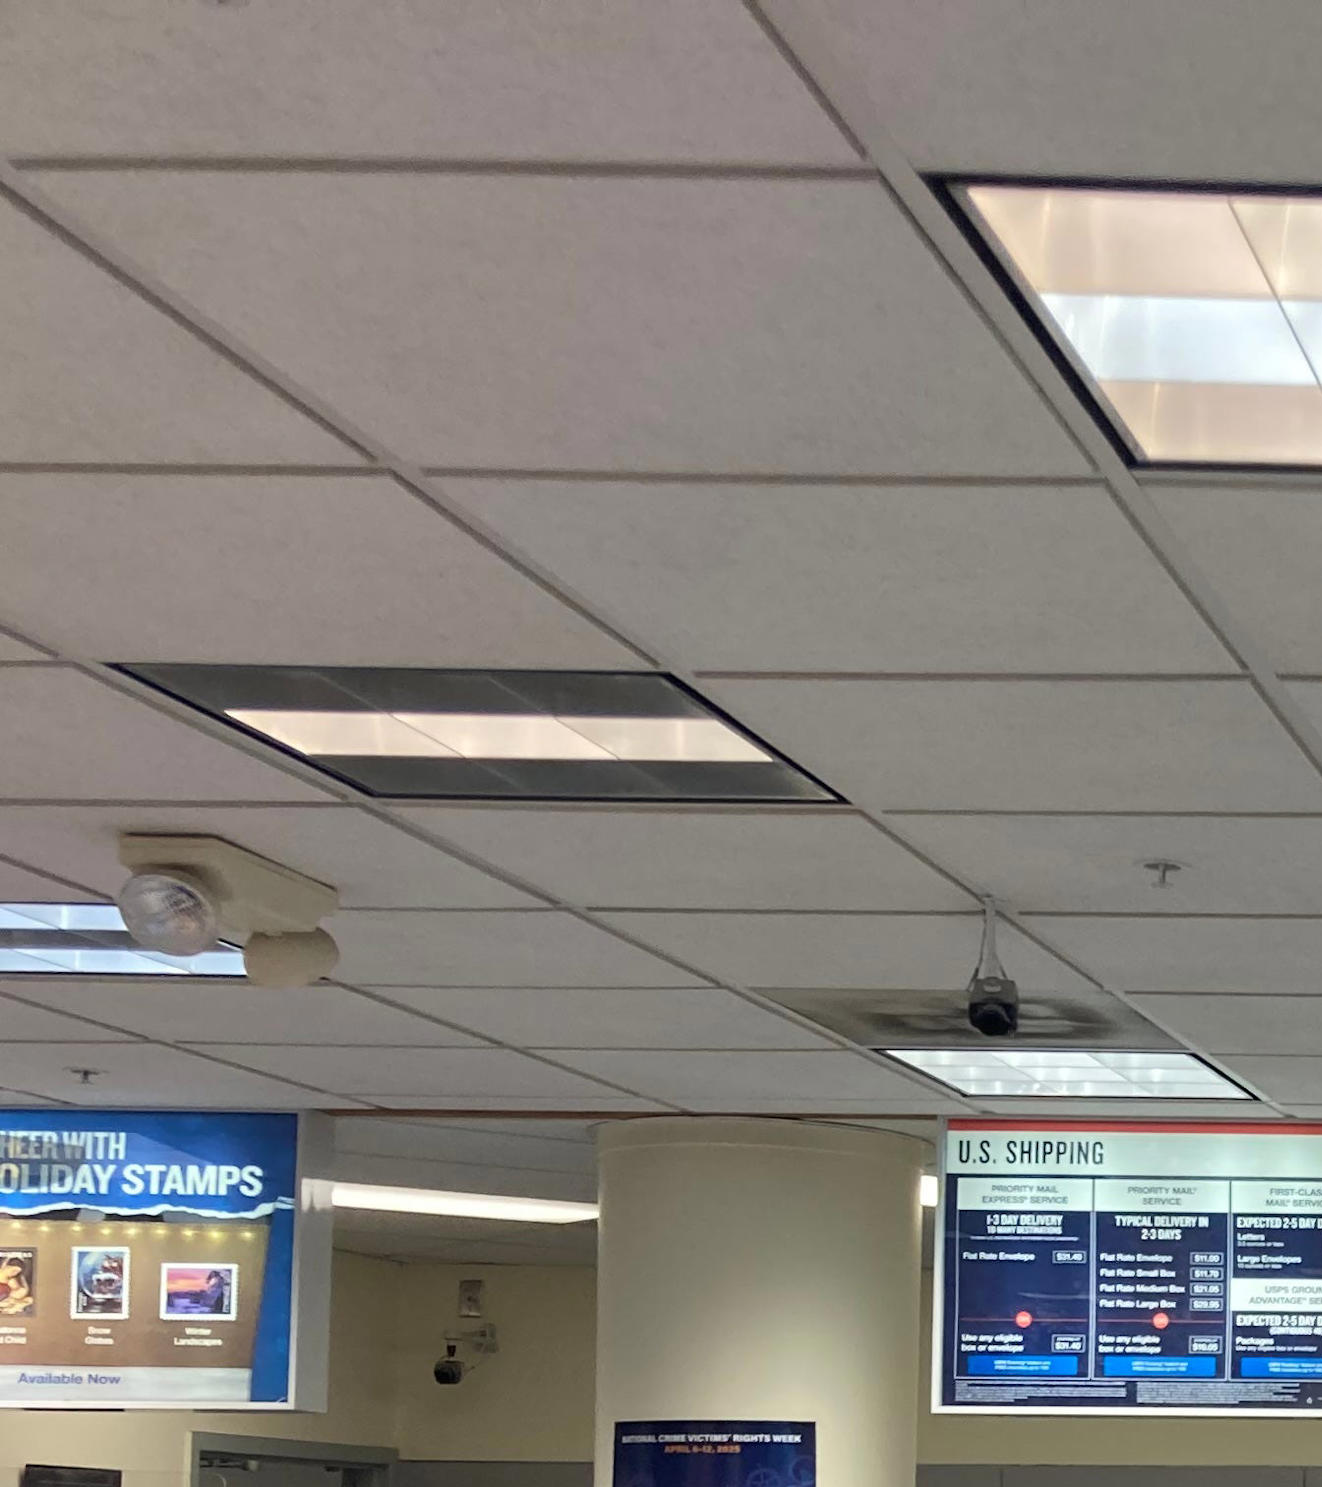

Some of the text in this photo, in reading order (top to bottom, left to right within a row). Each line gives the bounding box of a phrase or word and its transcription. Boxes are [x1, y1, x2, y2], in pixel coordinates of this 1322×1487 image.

[62, 1131, 126, 1160] WITH
[958, 1140, 1104, 1166] U.S. SHIPPING
[122, 1165, 264, 1197] STAMPS
[992, 1185, 1034, 1193] PRIORITY
[1128, 1187, 1169, 1195] PRIORITY
[1142, 1198, 1182, 1206] SERVICE
[1000, 1215, 1019, 1226] DAY
[1019, 1215, 1063, 1226] DELIVERY
[1115, 1215, 1152, 1227] TYPICAL
[1154, 1216, 1197, 1227] DELIVERY
[1237, 1217, 1282, 1229] EXPECTED
[1283, 1217, 1298, 1229] 2-5
[1299, 1218, 1317, 1229] DAY
[1141, 1229, 1182, 1240] 2-3 DAYS
[1265, 1286, 1289, 1294] USPS
[1236, 1315, 1282, 1326] EXPECTED
[1282, 1315, 1298, 1326] 2-5
[1298, 1315, 1316, 1327] DAY
[17, 1372, 122, 1385] Available Now
[658, 1435, 687, 1444] CRIME
[733, 1434, 771, 1443] RIGHTS
[772, 1434, 802, 1444] WEEK
